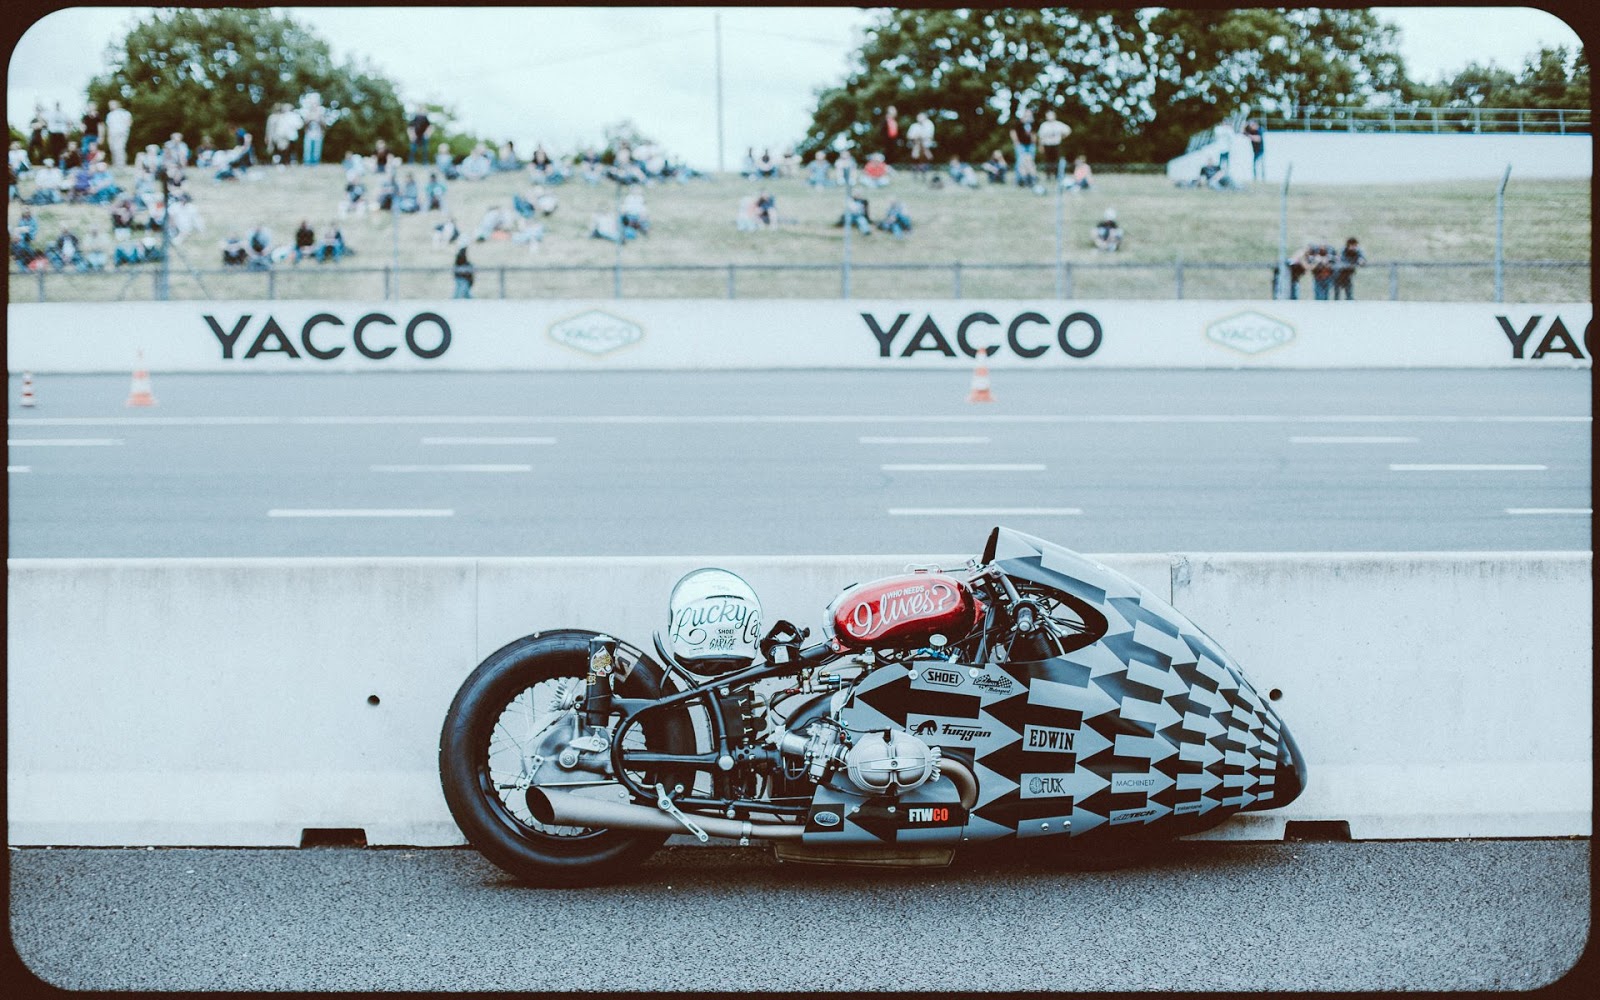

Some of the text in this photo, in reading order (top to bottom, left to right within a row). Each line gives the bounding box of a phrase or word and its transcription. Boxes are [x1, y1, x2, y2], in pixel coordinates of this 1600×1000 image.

[203, 312, 452, 360] YACCO
[860, 311, 1103, 359] YACCO
[1495, 315, 1591, 359] YA
[887, 585, 925, 599] WHO NEEDS
[846, 584, 951, 638] 9 lives?
[673, 600, 747, 645] Lucky
[927, 671, 959, 684] SHOEI
[942, 724, 992, 742] Furygan
[1029, 729, 1075, 750] EDWIN
[1116, 779, 1155, 787] MACHINE17
[908, 807, 949, 823] FTWCO
